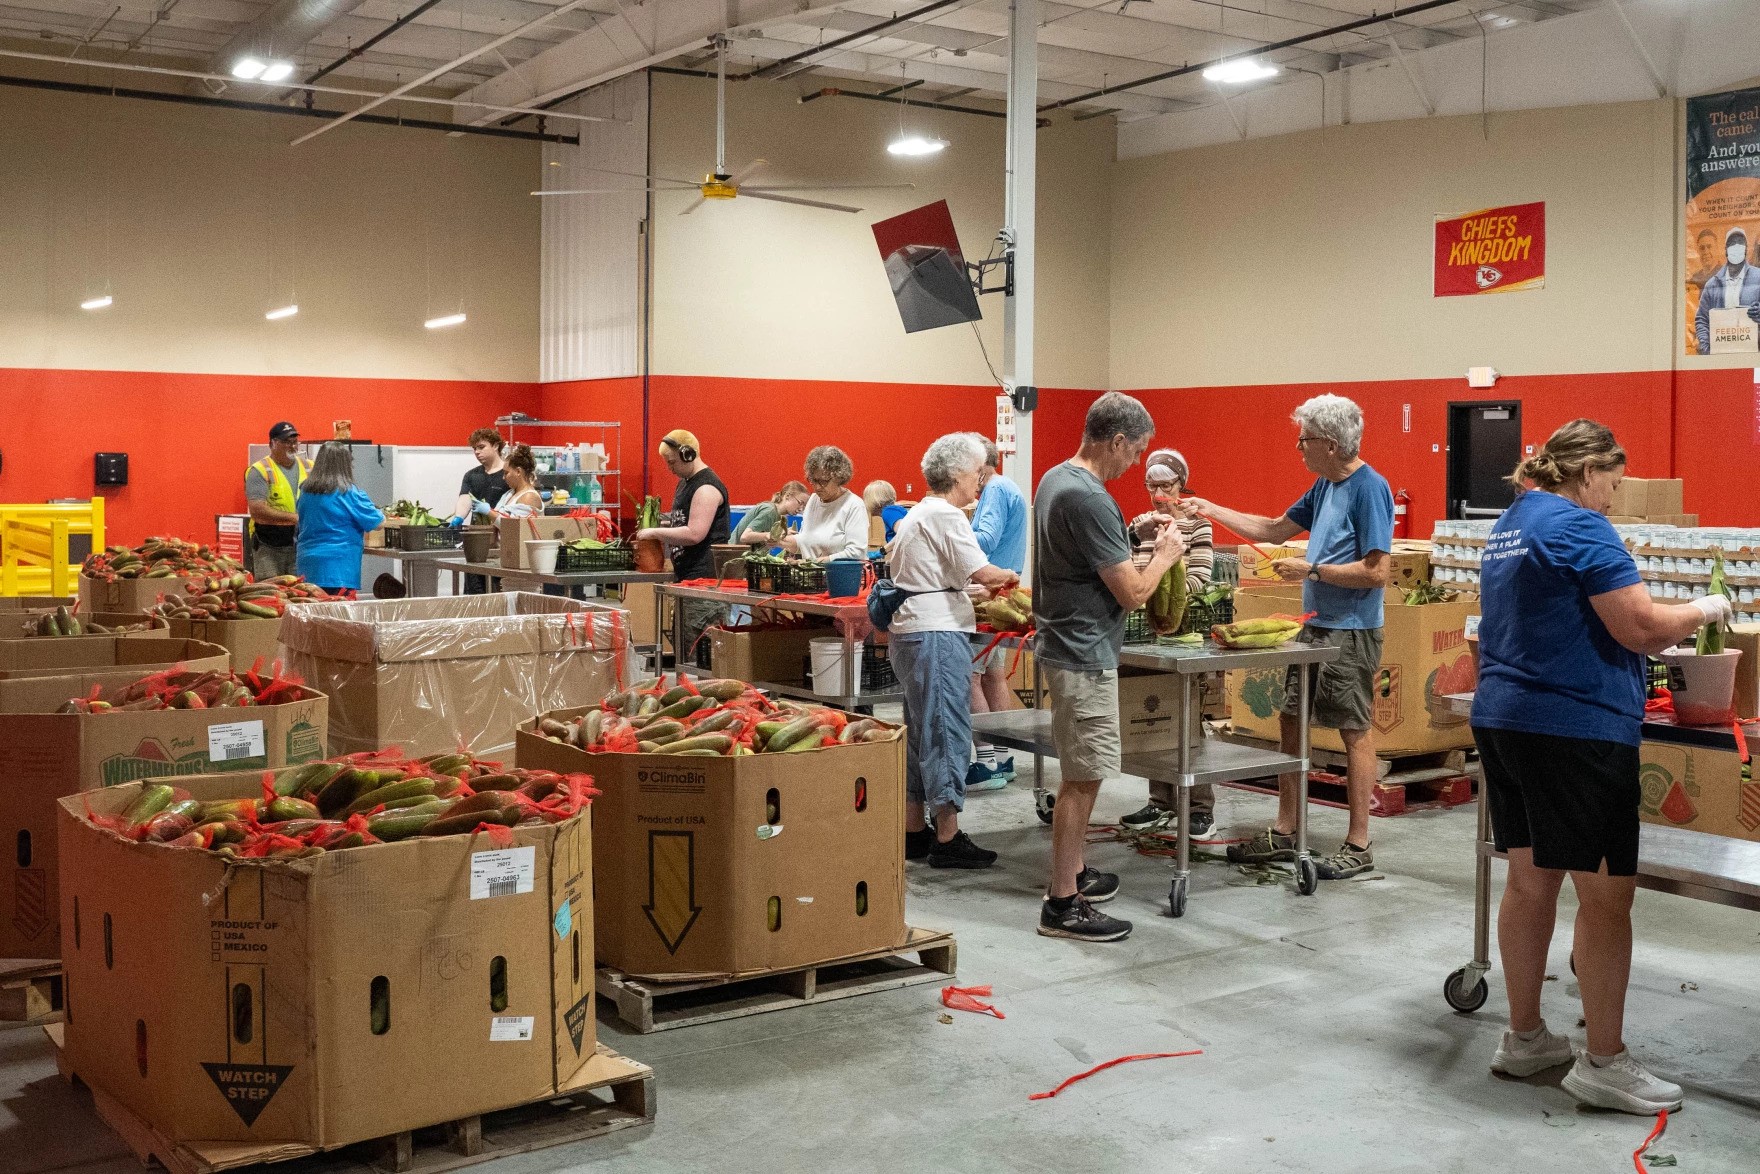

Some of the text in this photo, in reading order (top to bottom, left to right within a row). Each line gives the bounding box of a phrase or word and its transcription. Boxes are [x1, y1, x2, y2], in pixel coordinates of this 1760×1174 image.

[1709, 111, 1737, 126] The
[1716, 123, 1757, 138] came.
[1707, 142, 1737, 159] And
[1717, 203, 1757, 211] NEIGHBOR
[1461, 215, 1518, 241] CHIEFS
[1448, 235, 1532, 266] KINGDOM
[1715, 327, 1751, 335] FEEDING
[1715, 334, 1751, 342] AMERICA
[1497, 531, 1513, 539] LOVE
[1512, 529, 1521, 537] IT
[1505, 539, 1521, 547] PLAN
[1493, 548, 1529, 559] TOGETHER!
[1378, 710, 1392, 721] STEP
[170, 736, 196, 750] Fresh
[650, 771, 706, 784] ClimaBin
[637, 814, 706, 825] Product of USA
[211, 920, 279, 930] PRODUCT OF
[224, 932, 246, 940] USA
[224, 943, 268, 952] MEXICO
[218, 1070, 277, 1084] WATCH
[227, 1086, 270, 1100] STEP
